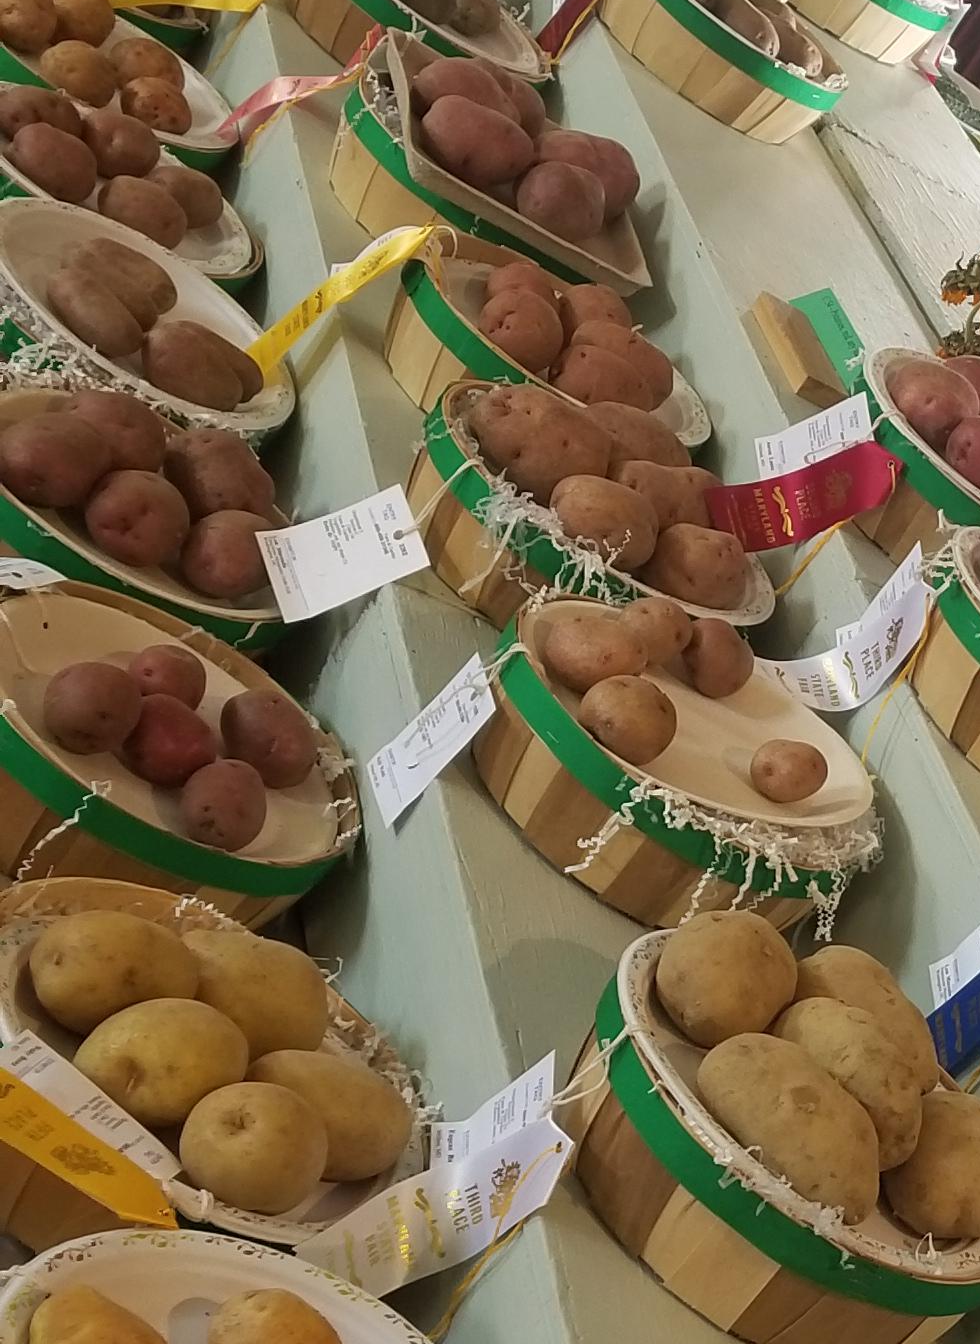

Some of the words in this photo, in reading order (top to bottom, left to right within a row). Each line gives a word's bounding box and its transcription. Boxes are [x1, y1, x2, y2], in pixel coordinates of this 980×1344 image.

[753, 488, 776, 544] MARYLAND
[794, 488, 812, 521] PLACE
[861, 649, 874, 680] PLACE
[869, 641, 881, 671] THIRD
[810, 673, 825, 698] STATE
[447, 1189, 470, 1234] PLACE
[464, 1184, 484, 1226] THIRD
